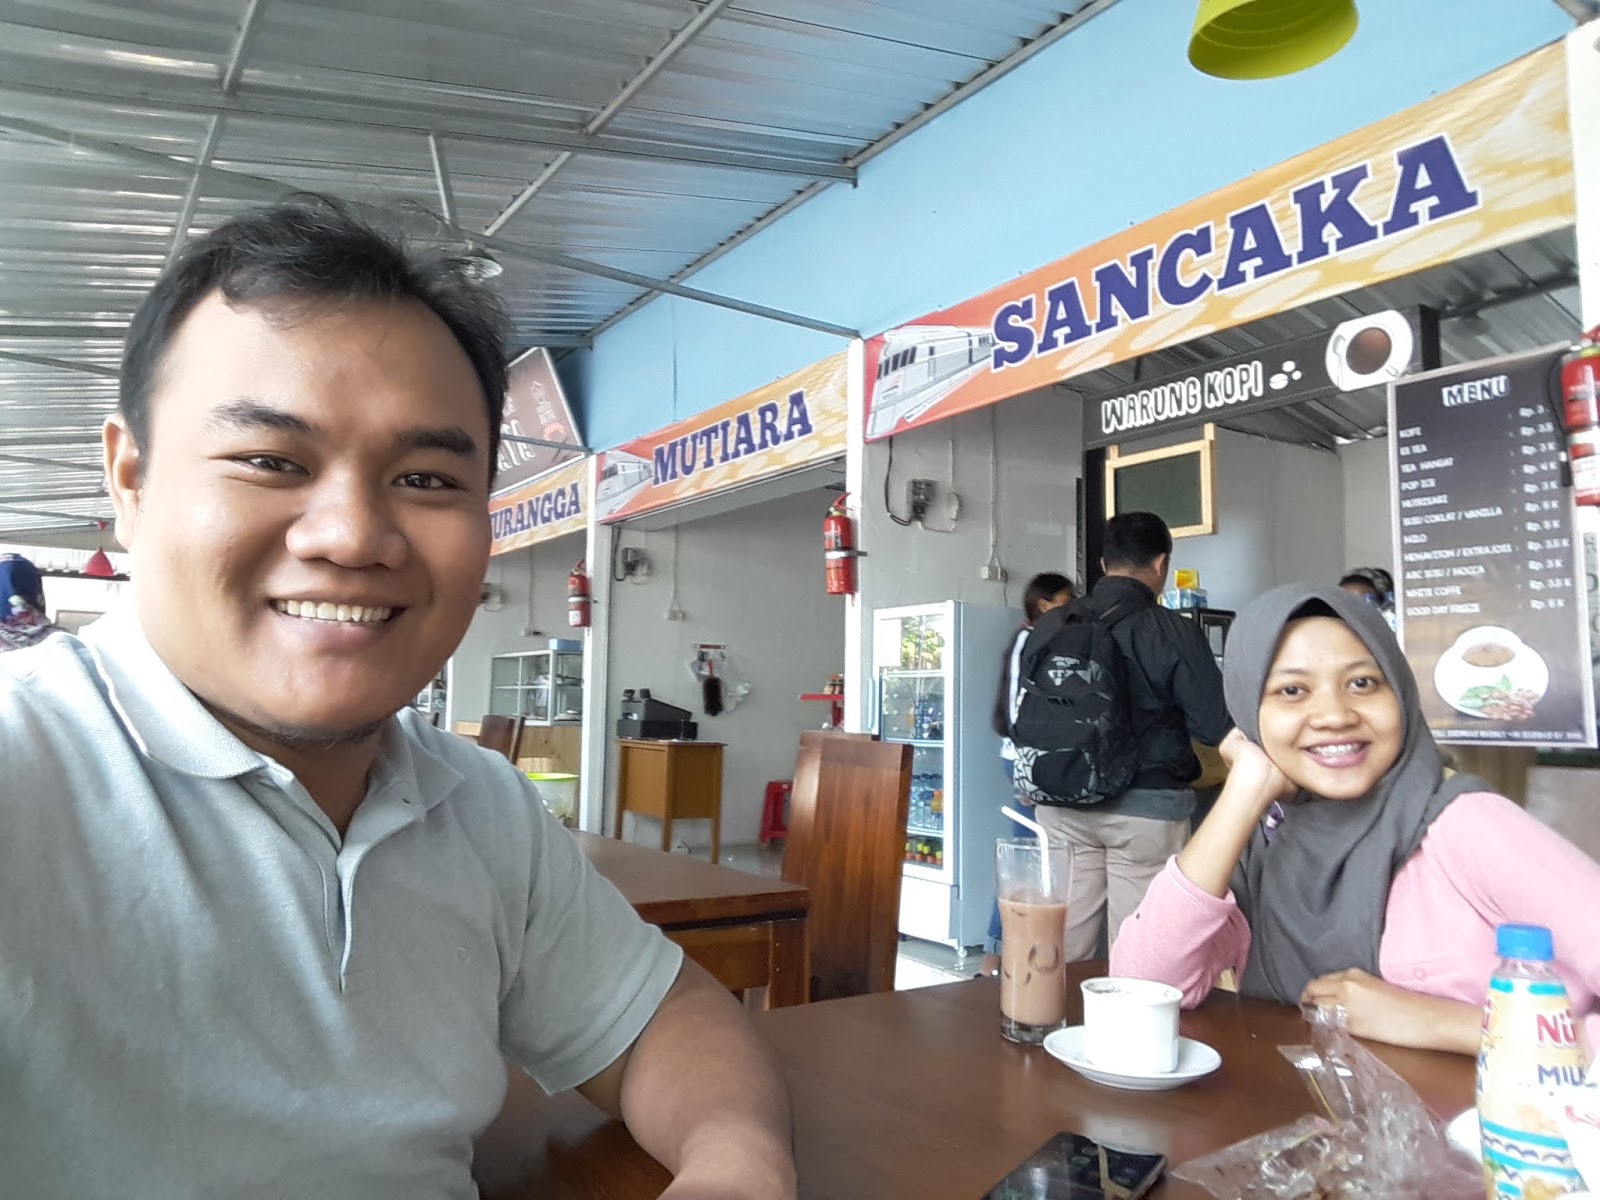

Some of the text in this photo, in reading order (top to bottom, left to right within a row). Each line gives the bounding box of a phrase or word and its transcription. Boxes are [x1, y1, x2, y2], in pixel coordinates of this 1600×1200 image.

[991, 135, 1479, 369] SANCAKA
[1101, 361, 1263, 434] WARUNG KOPI
[1441, 375, 1510, 407] MENU
[653, 390, 813, 486] MUTIARA
[490, 482, 581, 539] URANGGA
